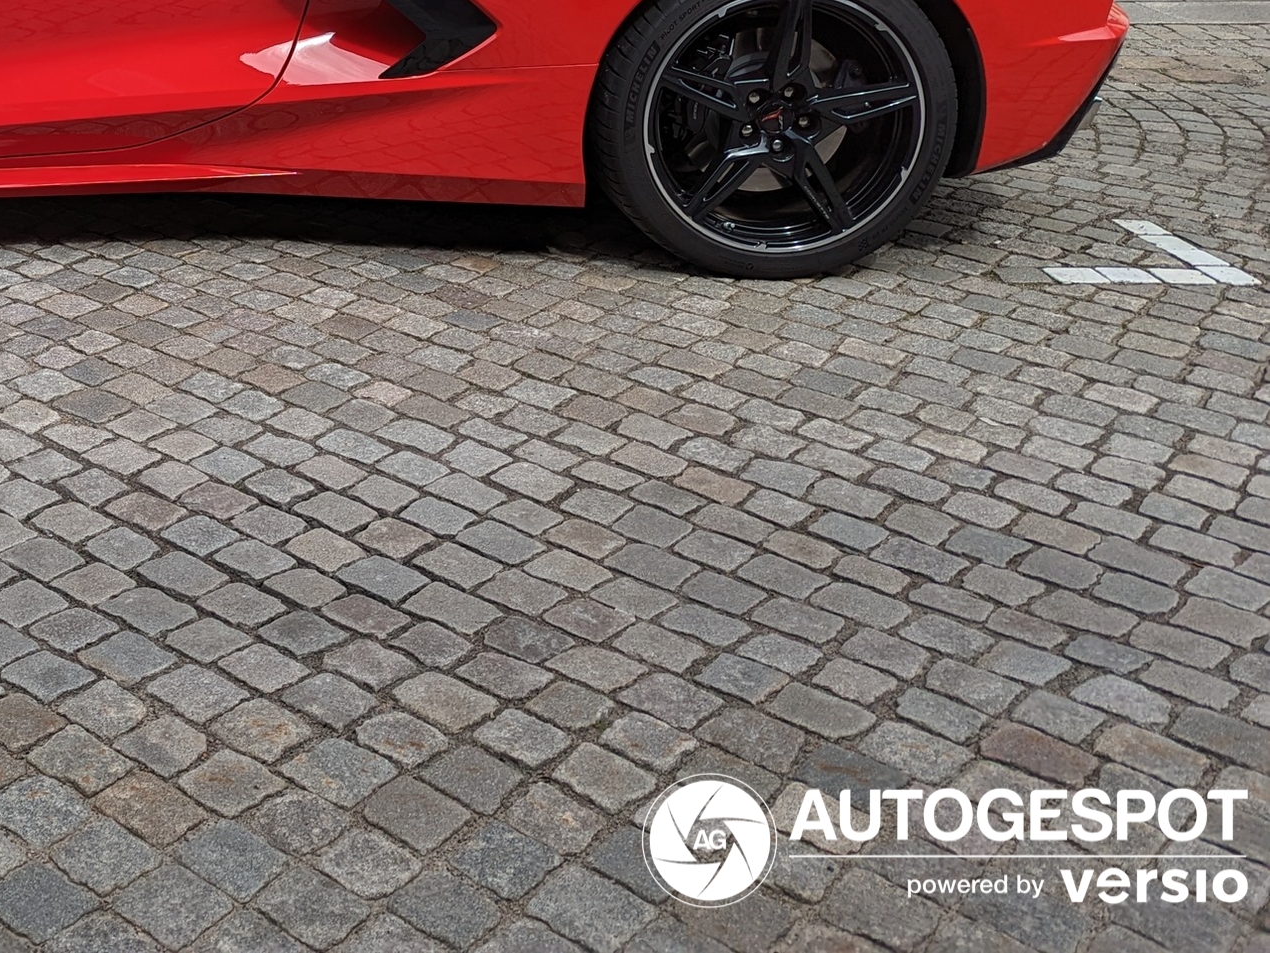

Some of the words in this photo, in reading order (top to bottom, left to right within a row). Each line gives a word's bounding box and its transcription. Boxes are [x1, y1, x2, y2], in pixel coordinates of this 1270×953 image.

[660, 19, 679, 40] PILOT
[678, 0, 701, 22] SPORT
[625, 44, 658, 124] MICHELIN
[911, 123, 946, 201] MICHELIN
